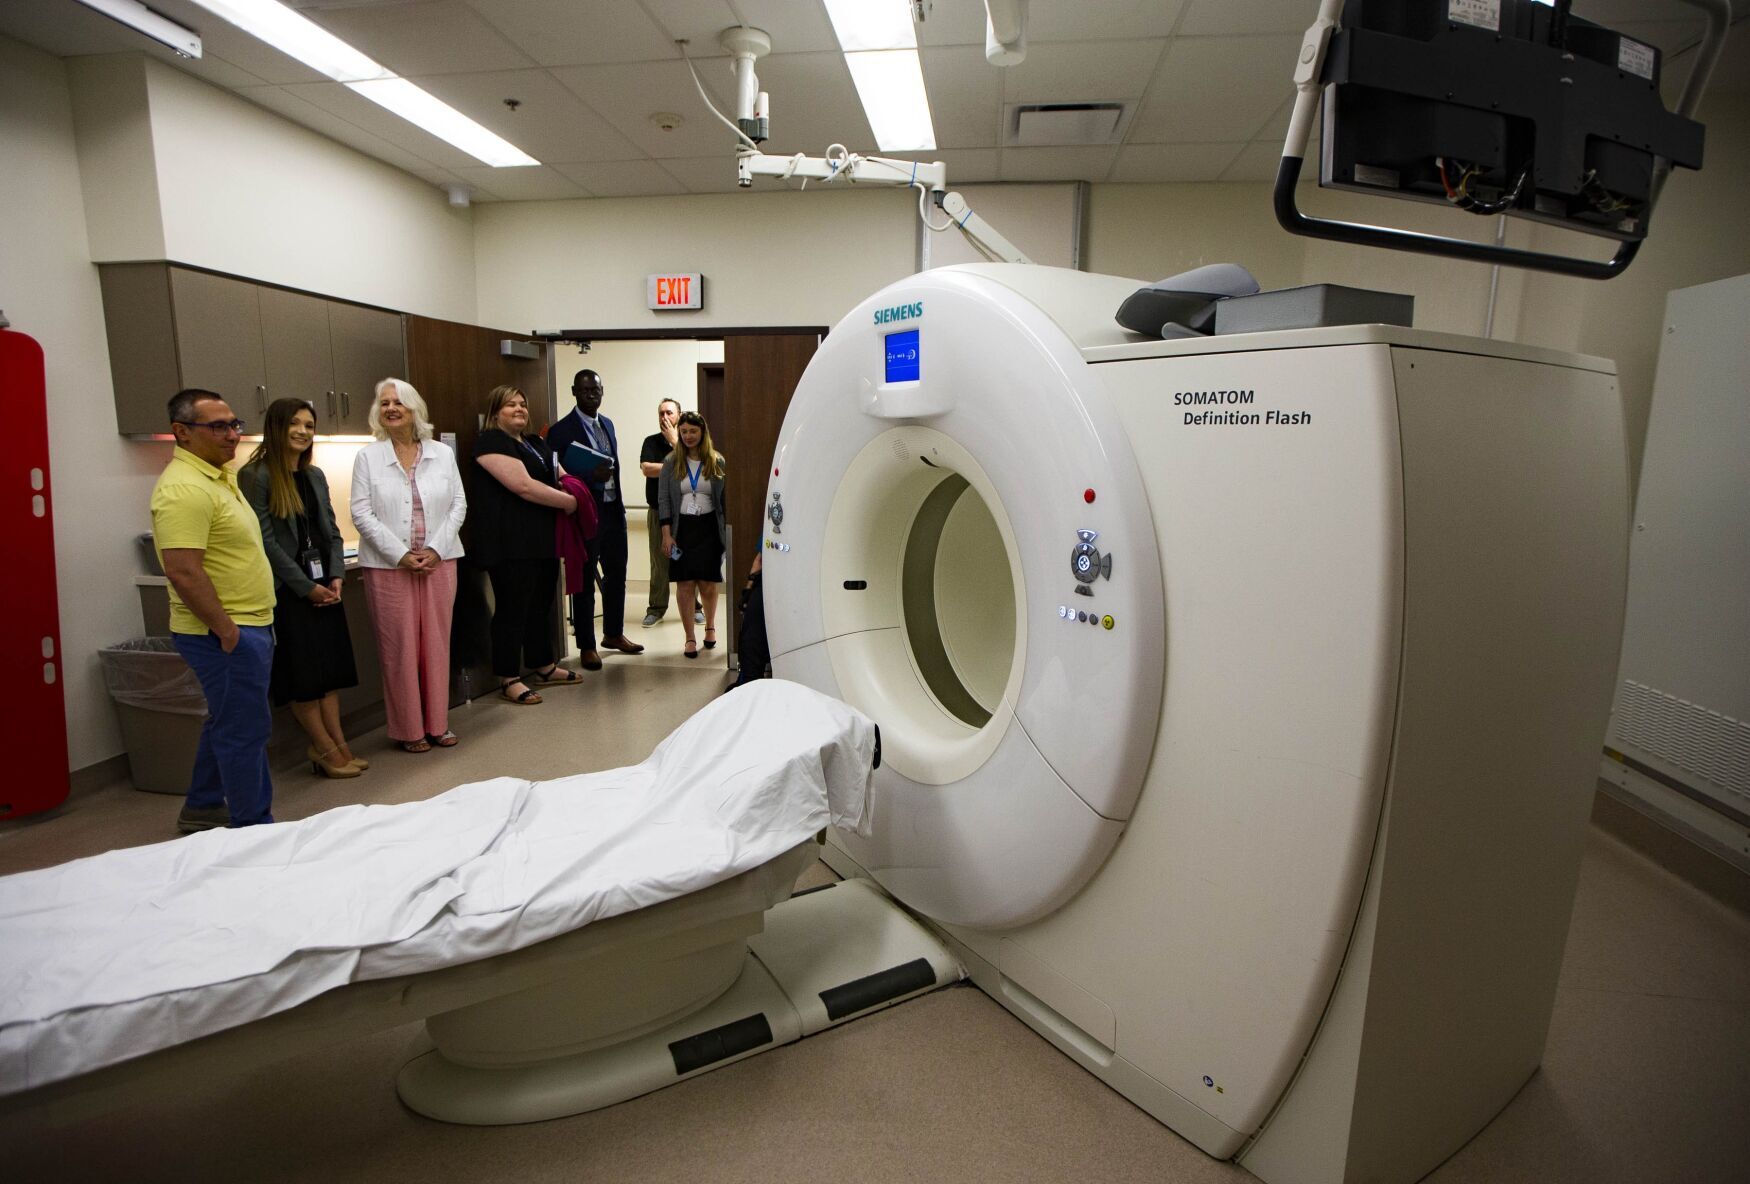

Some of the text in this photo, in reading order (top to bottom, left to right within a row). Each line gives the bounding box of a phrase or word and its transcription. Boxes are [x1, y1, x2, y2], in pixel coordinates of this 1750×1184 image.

[657, 278, 690, 305] EXIT
[873, 301, 923, 325] SIEMENS
[1174, 390, 1255, 406] SOMATOM
[1183, 410, 1312, 425] Definition Flash
